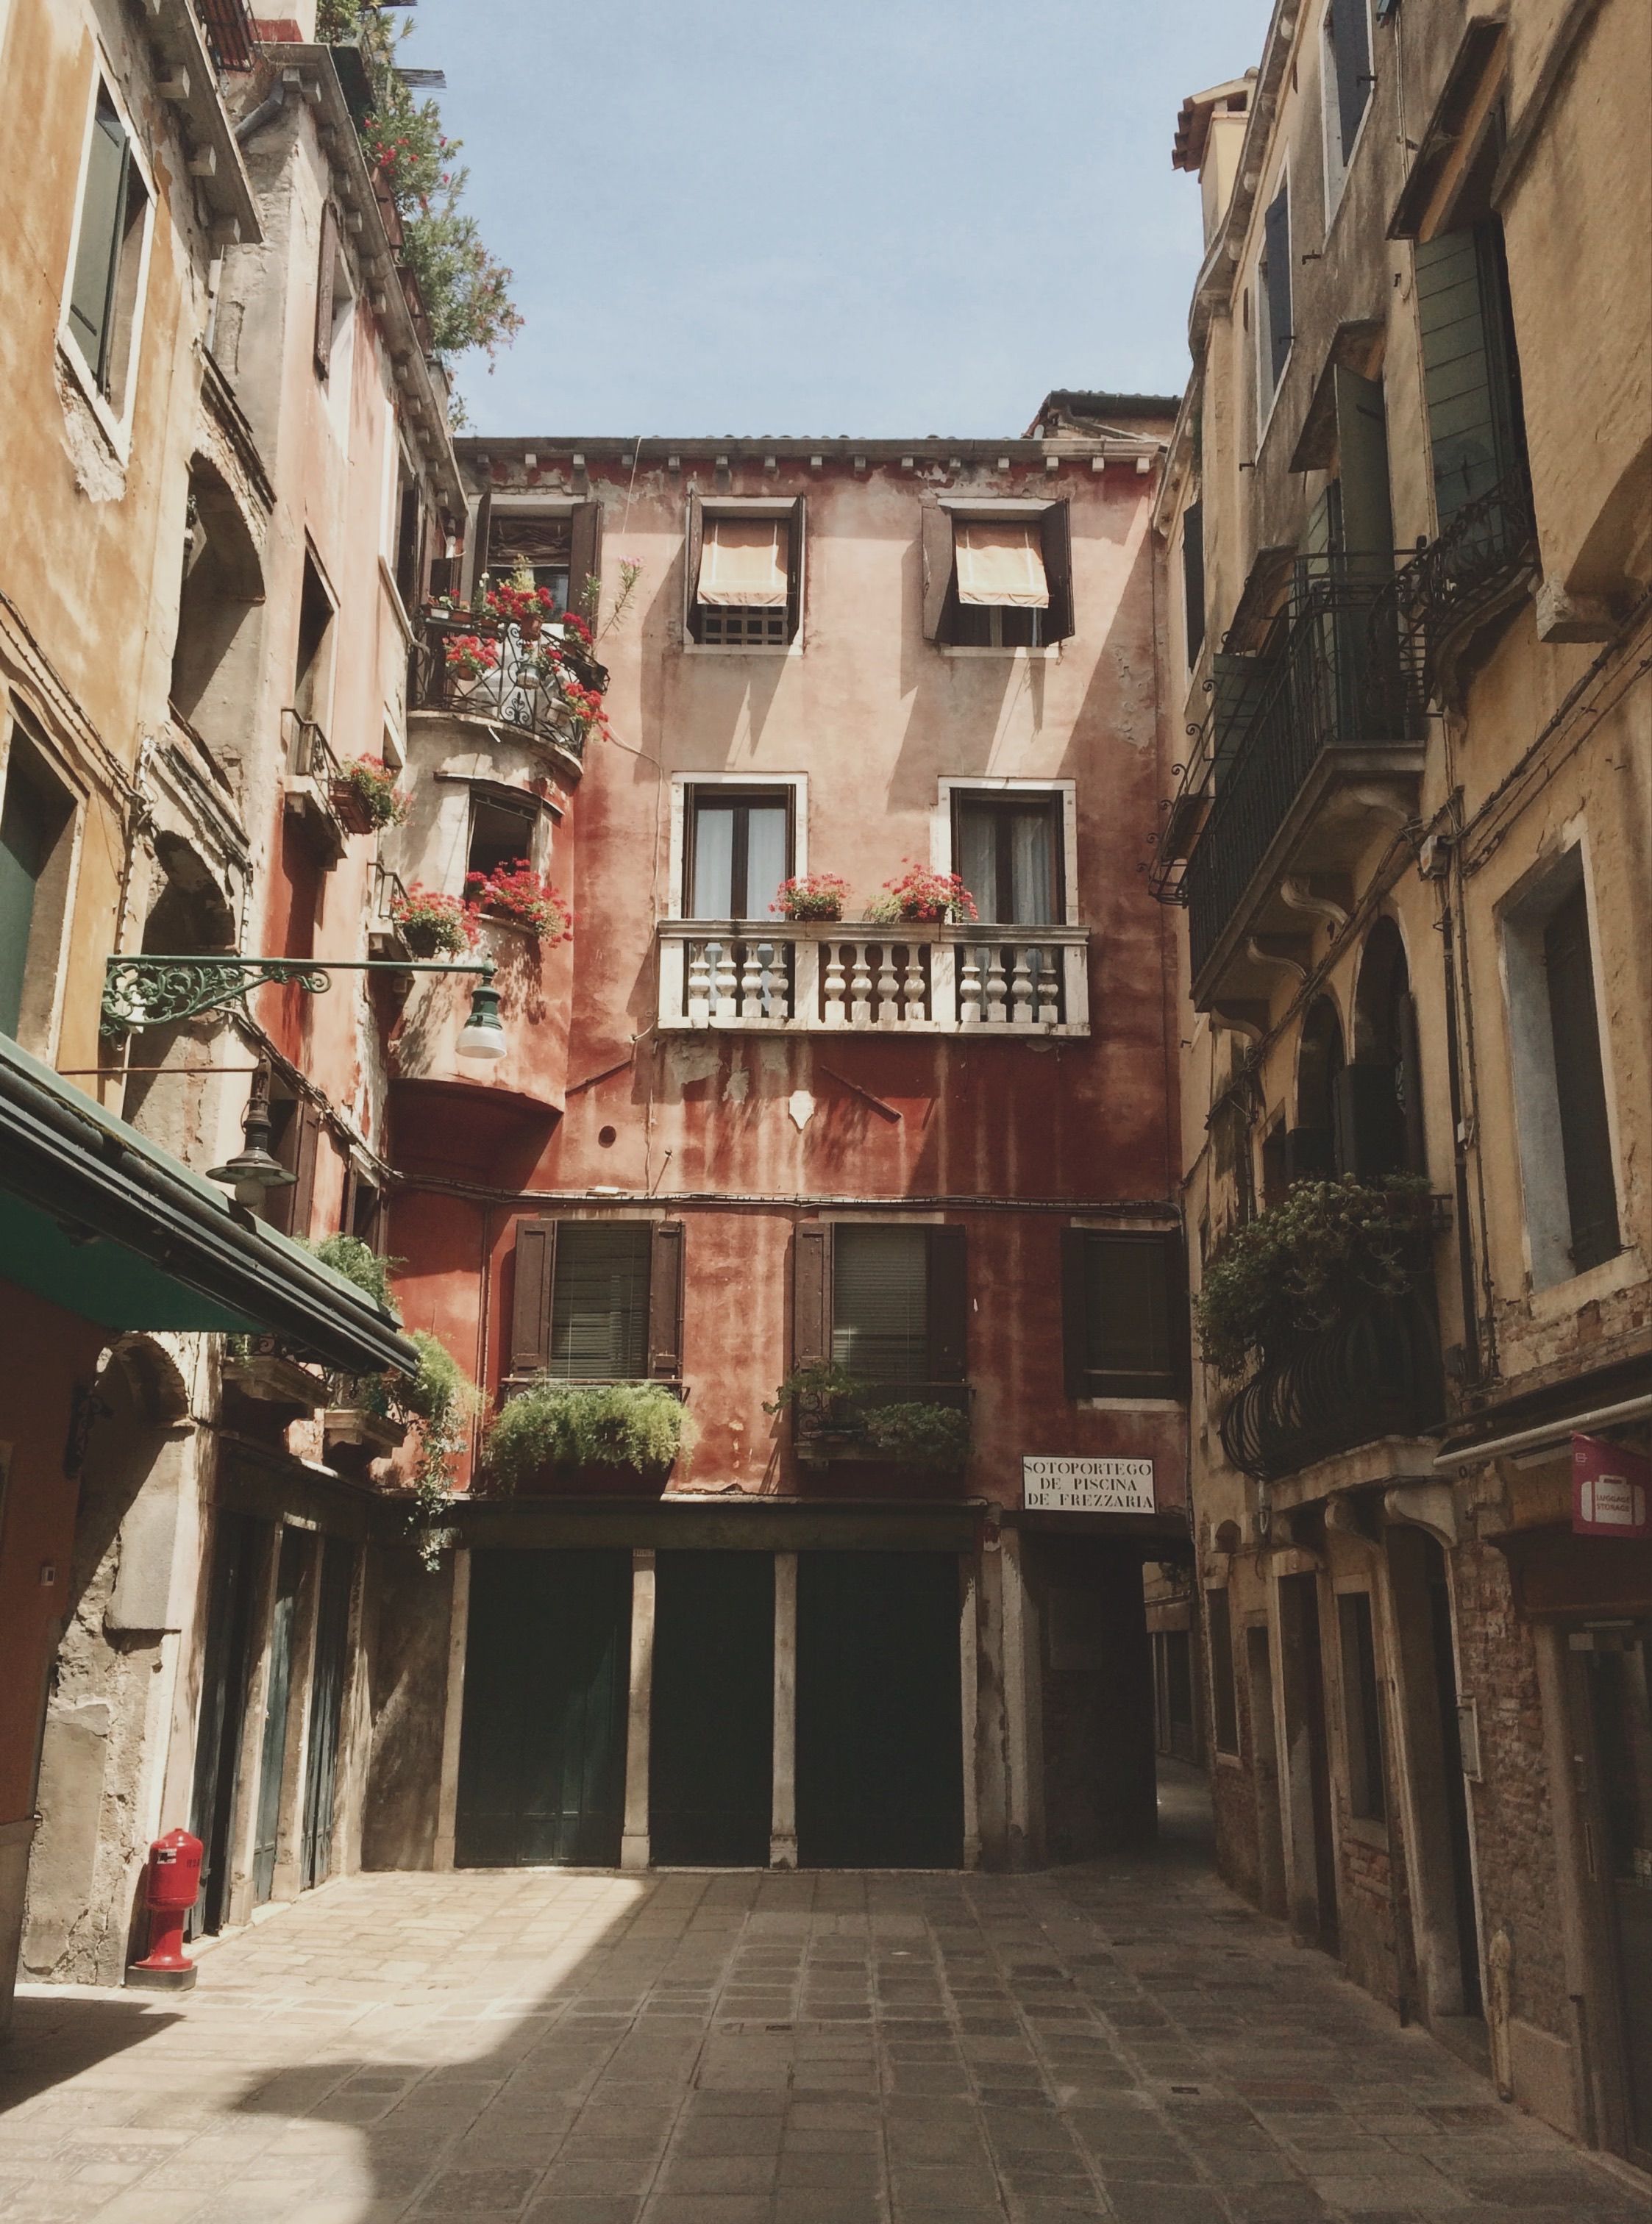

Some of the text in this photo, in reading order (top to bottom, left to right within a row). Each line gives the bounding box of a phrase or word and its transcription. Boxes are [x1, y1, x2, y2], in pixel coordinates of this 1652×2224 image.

[1023, 1461, 1153, 1476] SOTOPORTEGO
[1040, 1478, 1137, 1491] DE PISCINA
[1028, 1493, 1153, 1508] DE FREZZARIA
[1596, 1494, 1630, 1503] LUGGAGE
[1596, 1503, 1630, 1512] STORAGE
